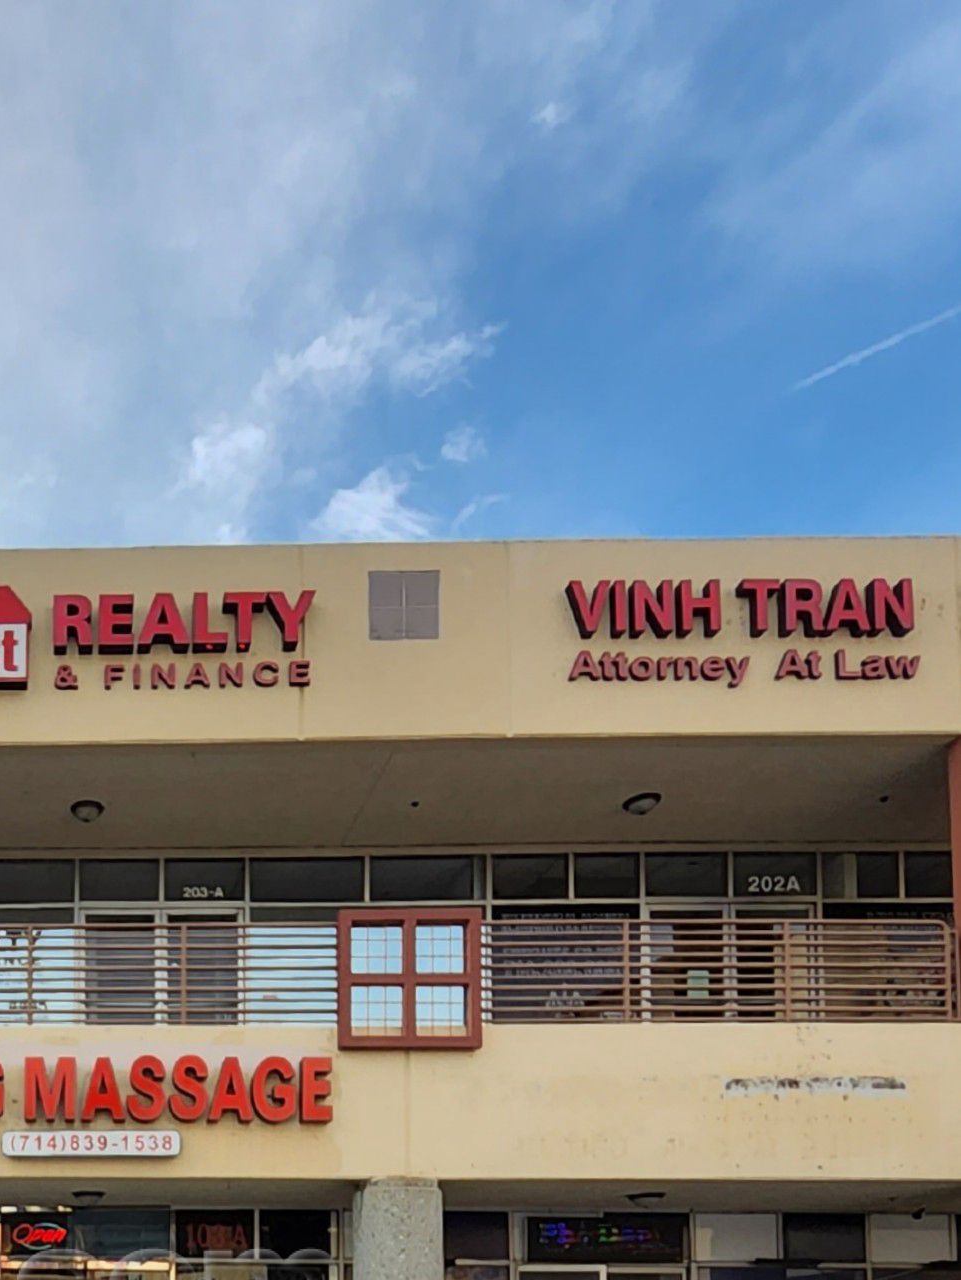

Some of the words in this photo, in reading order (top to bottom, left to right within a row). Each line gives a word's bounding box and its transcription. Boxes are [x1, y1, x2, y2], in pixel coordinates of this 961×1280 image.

[52, 590, 317, 655] REALTY
[566, 579, 722, 639] VINH
[736, 578, 915, 639] TRAN
[53, 664, 79, 690] &
[103, 660, 312, 691] FINANCE
[568, 650, 750, 689] Attorney
[774, 649, 822, 682] At
[834, 649, 921, 681] Law
[183, 886, 224, 898] 203-A
[746, 875, 802, 893] 202A
[23, 1054, 334, 1125] MASSAGE
[9, 1134, 174, 1154] (714)839-1538
